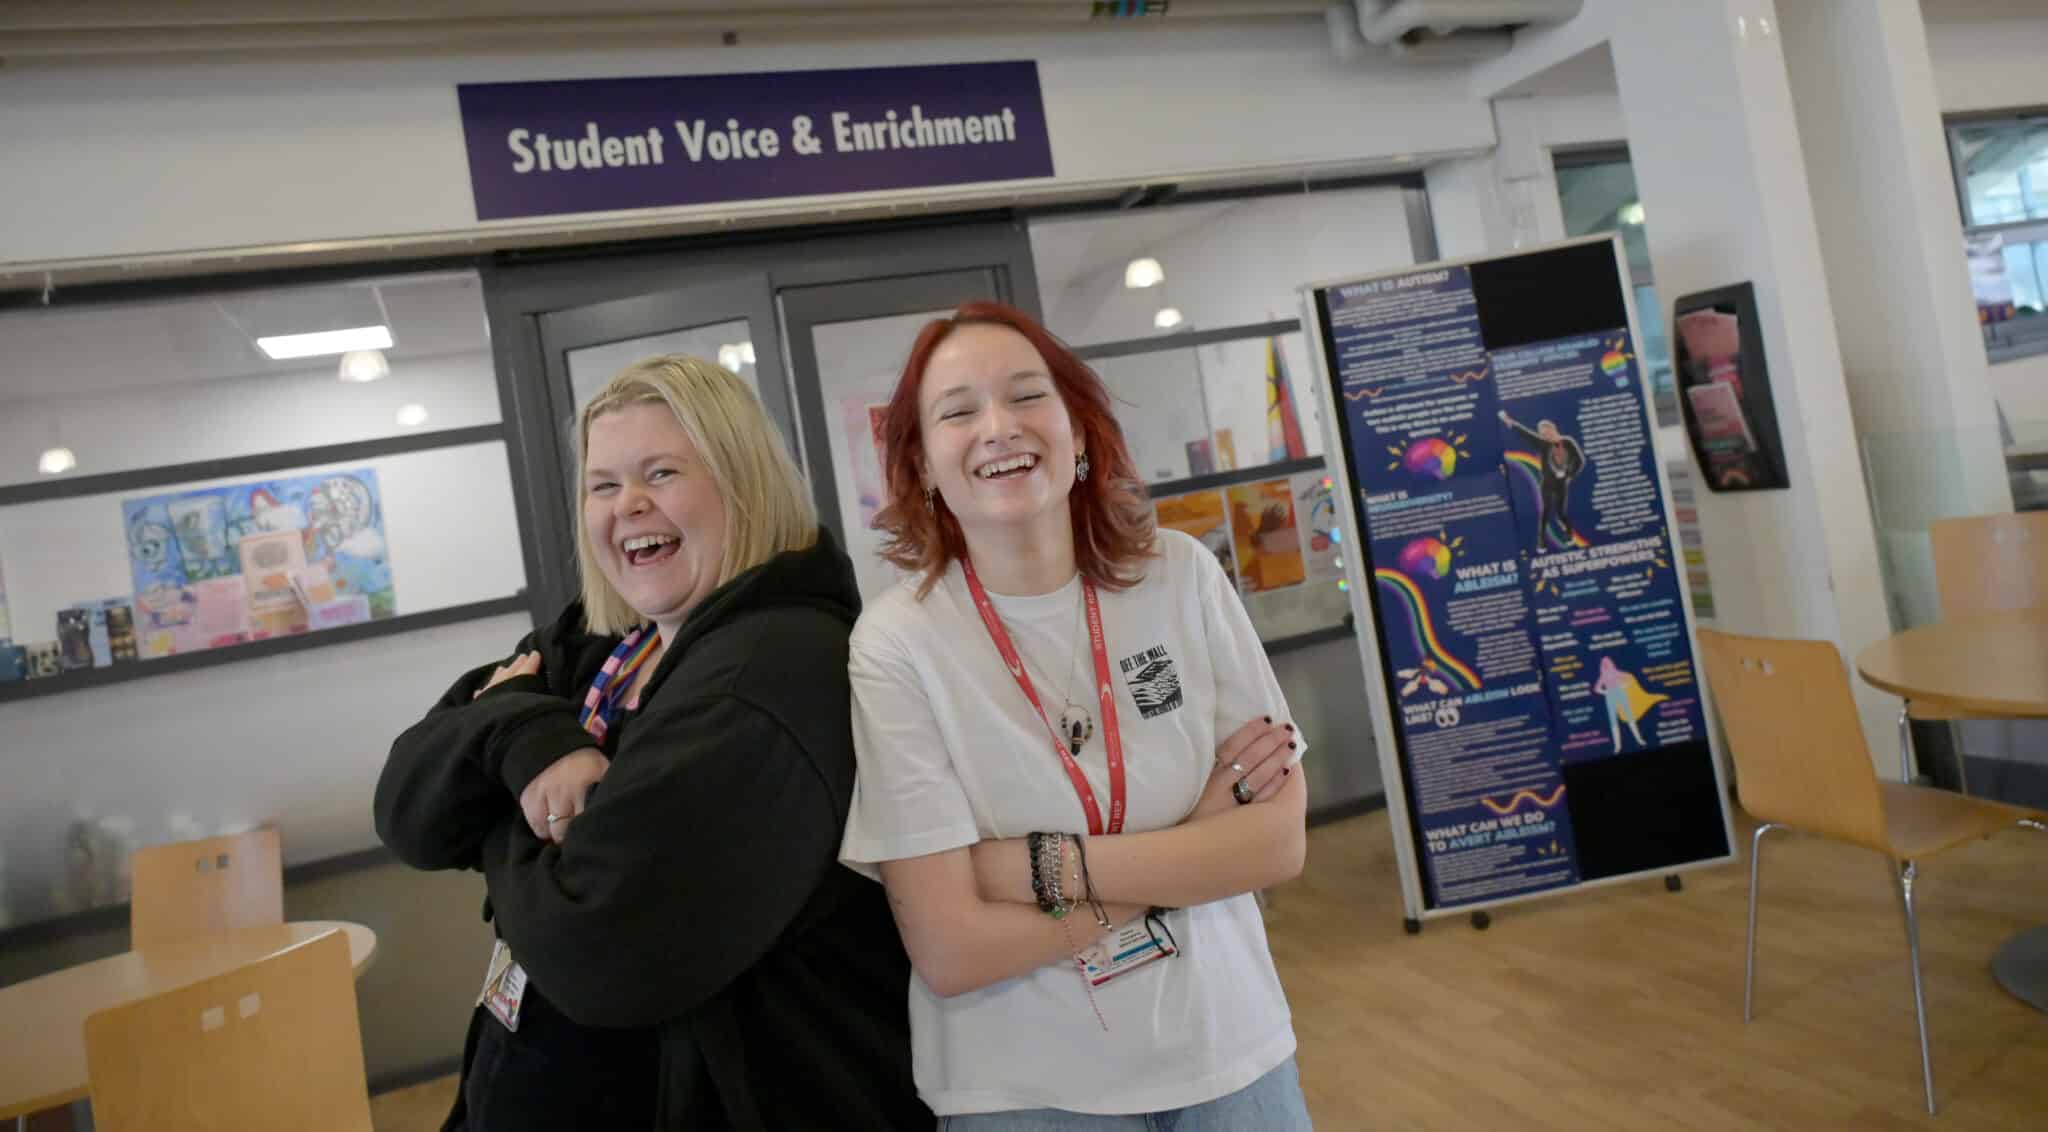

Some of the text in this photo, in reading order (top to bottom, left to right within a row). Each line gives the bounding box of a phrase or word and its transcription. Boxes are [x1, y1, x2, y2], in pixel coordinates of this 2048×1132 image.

[507, 105, 1017, 173] Student Voice & Enrichment
[1340, 270, 1450, 297] WHAT IS AUTISM?
[1366, 489, 1408, 505] WHAT IS
[1531, 535, 1662, 569] AUTISTIC STRENGTHS
[1541, 549, 1656, 580] AS SUPERPOWERS
[1455, 559, 1518, 580] WHAT IS
[1454, 573, 1519, 595] ABLEISM?
[1133, 651, 1148, 668] THE
[1146, 644, 1168, 661] WALL
[1403, 700, 1437, 715] WHAT
[1438, 696, 1463, 708] CAN
[1464, 688, 1509, 704] ABLEISM
[1510, 682, 1542, 696] LOOK
[1404, 710, 1434, 726] LIKE?
[1425, 811, 1545, 841] WHAT CAN WE DO
[1427, 820, 1556, 853] TO AVERT ABLEISM?
